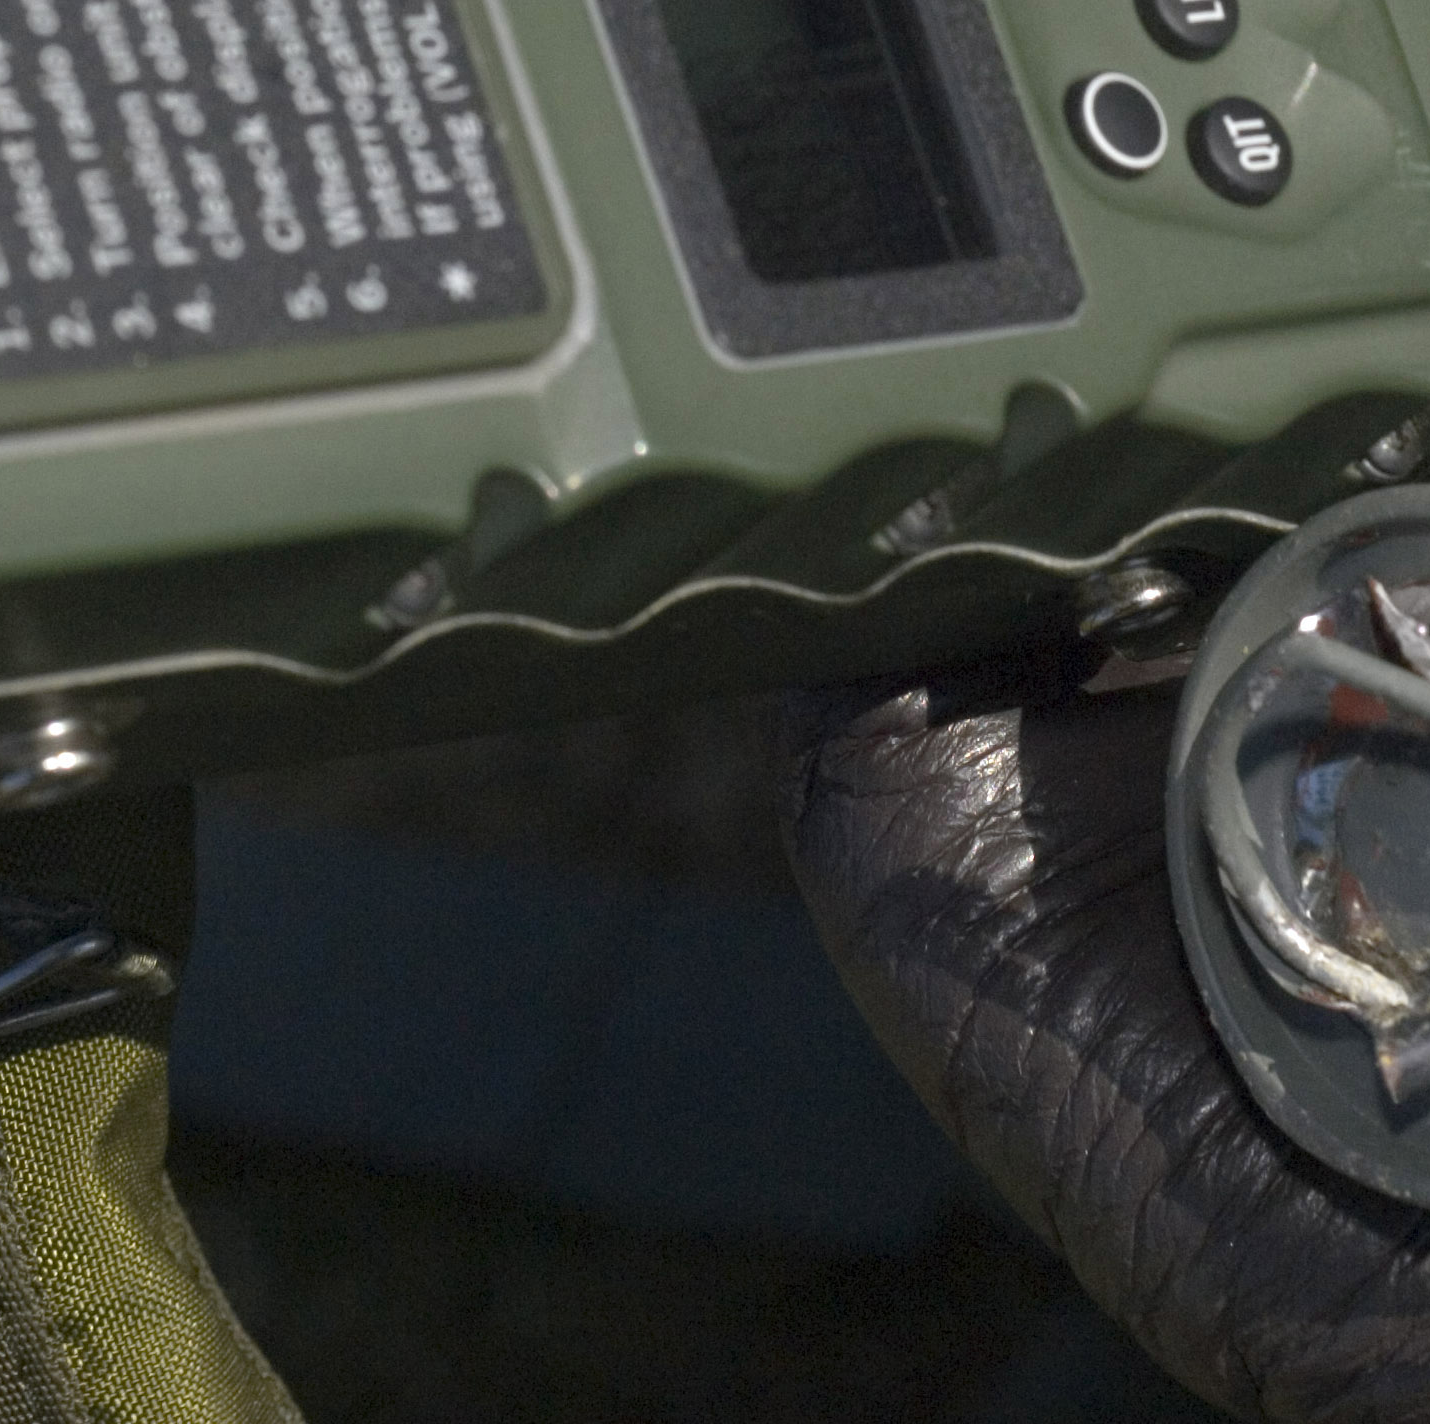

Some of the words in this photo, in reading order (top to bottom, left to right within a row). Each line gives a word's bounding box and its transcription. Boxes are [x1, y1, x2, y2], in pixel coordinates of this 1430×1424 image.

[38, 43, 101, 162] radio
[156, 89, 206, 137] of
[443, 111, 506, 230] using
[1231, 118, 1280, 172] QIT
[116, 90, 199, 268] Position
[183, 146, 246, 261] clear
[233, 112, 307, 254] Check
[304, 122, 368, 249] When
[76, 167, 134, 276] Turn
[414, 202, 460, 236] If
[173, 285, 216, 334] 4.
[284, 272, 328, 321] 5.
[345, 264, 389, 313] 6.
[48, 300, 96, 349] 2.
[111, 293, 157, 339] 3.
